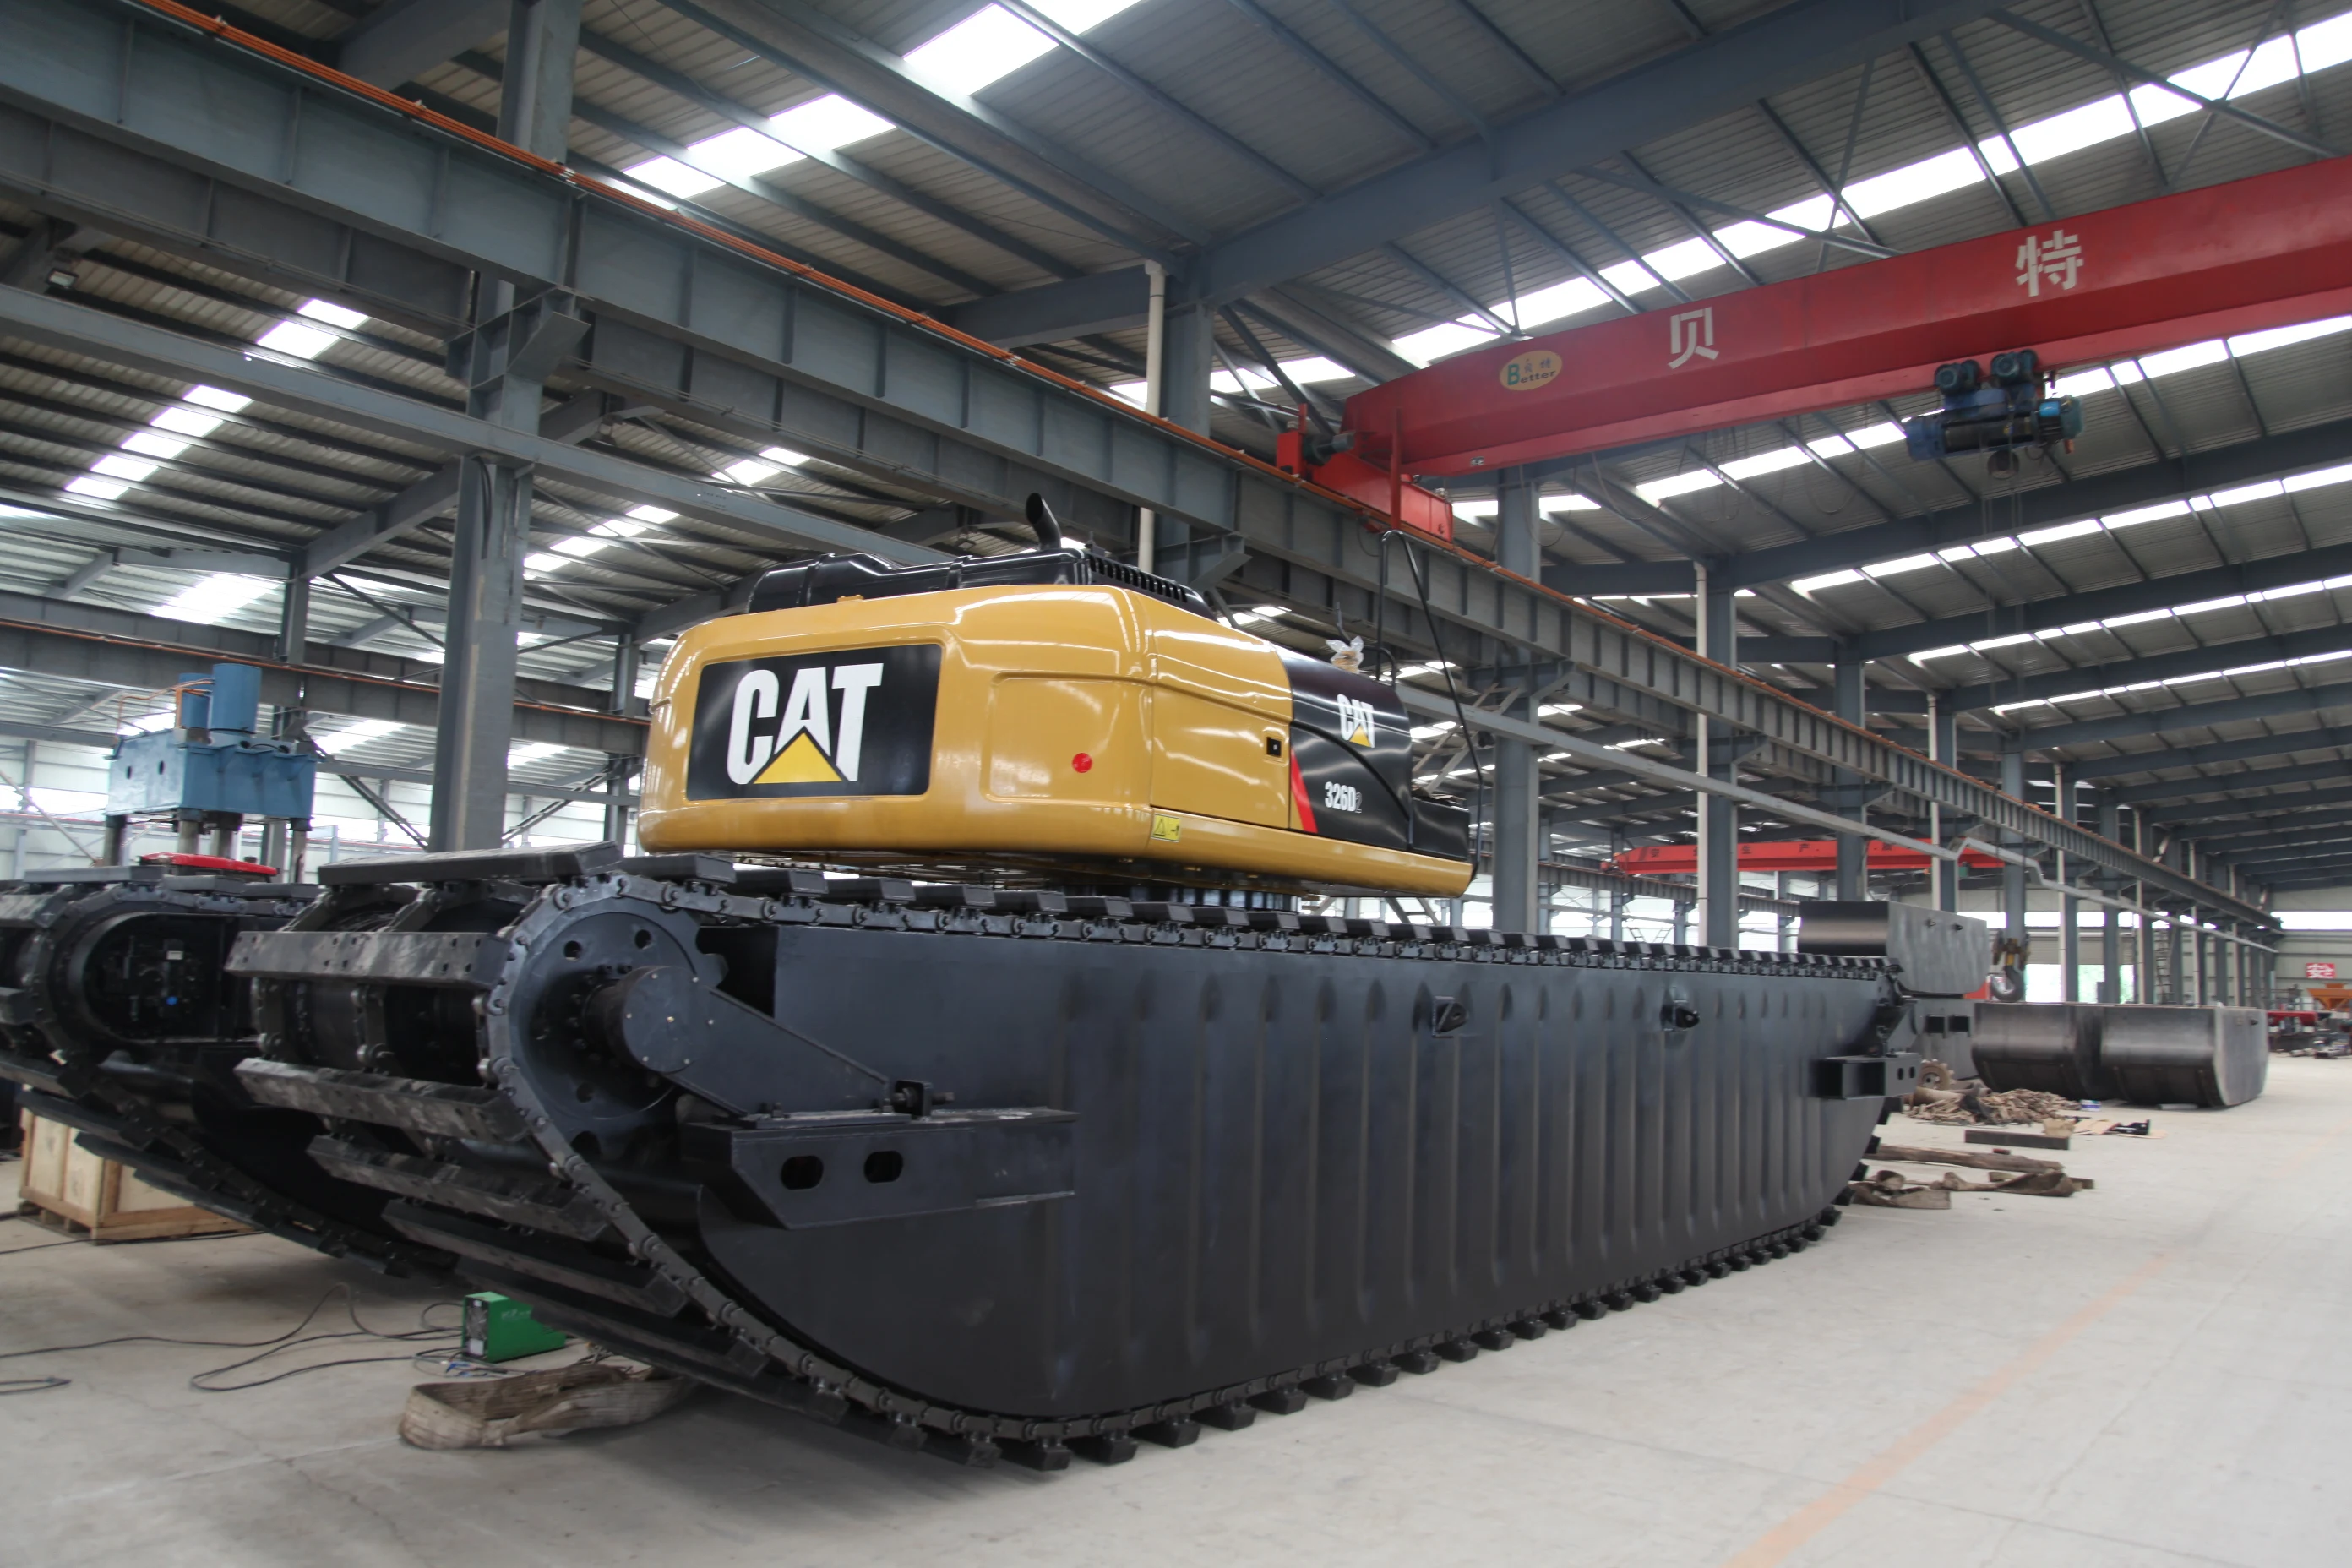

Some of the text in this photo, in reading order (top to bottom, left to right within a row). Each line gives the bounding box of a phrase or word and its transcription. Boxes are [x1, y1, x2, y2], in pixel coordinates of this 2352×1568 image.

[1667, 229, 2084, 369] 贝 特
[1507, 362, 1556, 386] Better
[727, 662, 885, 785] CAT
[1337, 694, 1375, 749] CAT
